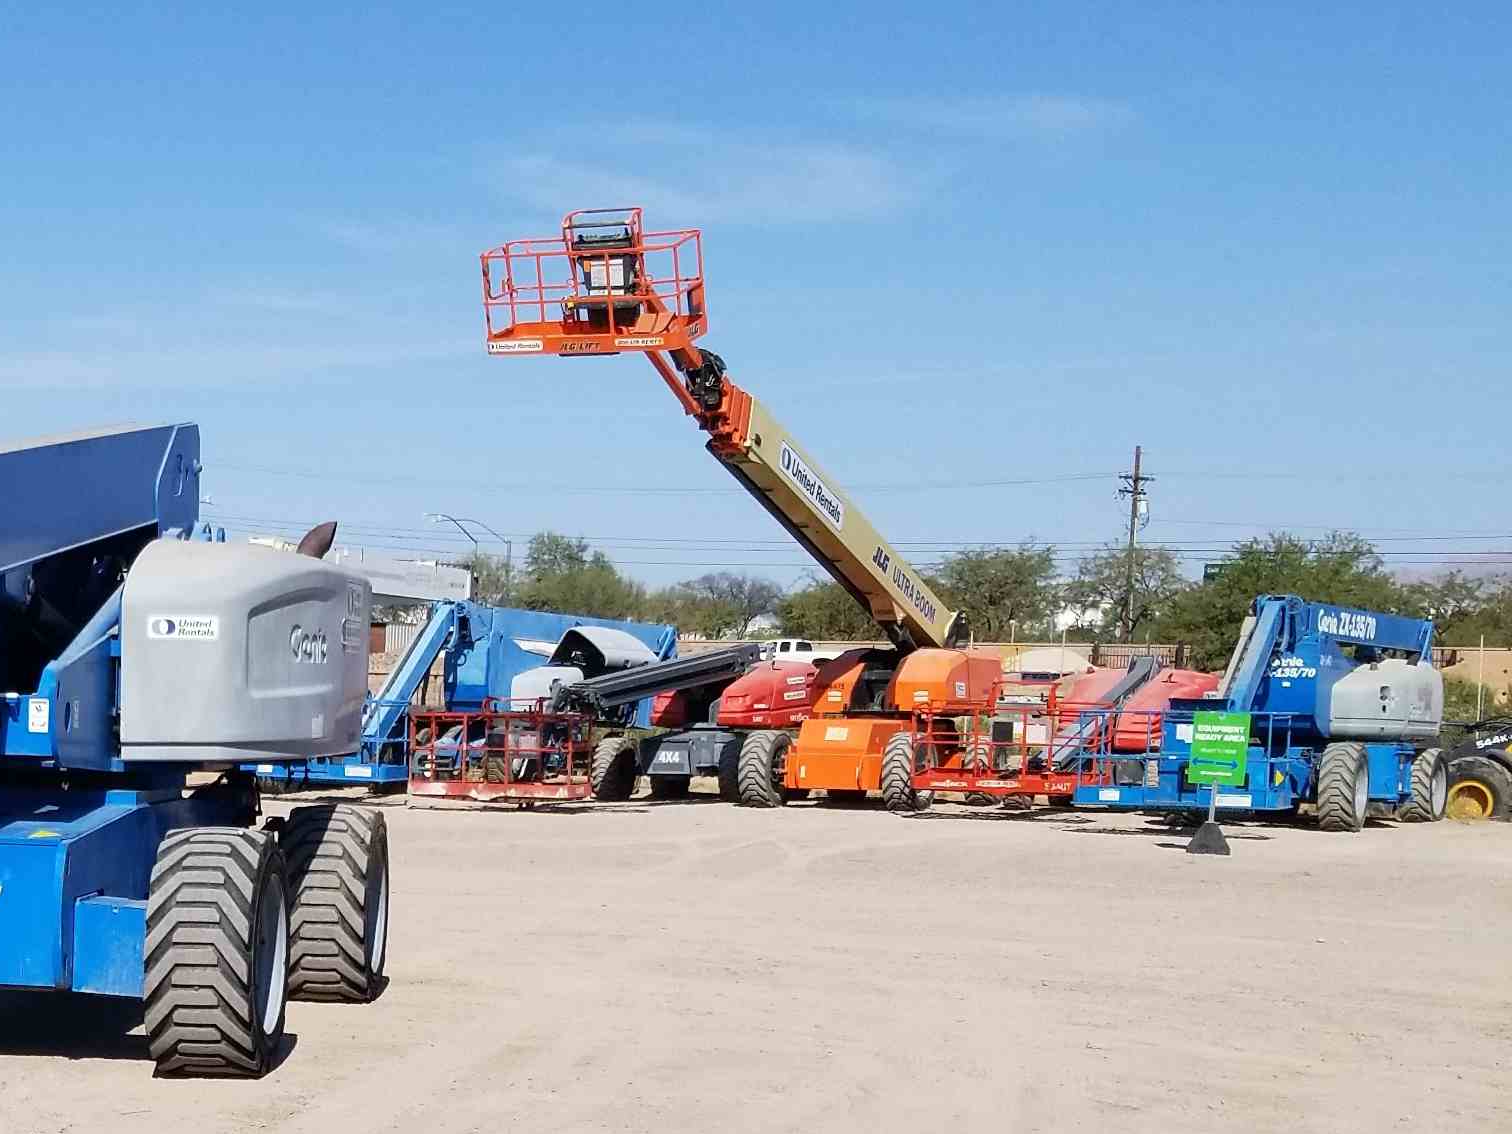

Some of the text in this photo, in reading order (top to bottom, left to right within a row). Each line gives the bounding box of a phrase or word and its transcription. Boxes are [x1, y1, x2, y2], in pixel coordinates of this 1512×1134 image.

[792, 459, 841, 524] United Rentals
[872, 546, 937, 625] JLG ULTRA BOOM
[178, 619, 212, 628] United
[178, 628, 215, 637] Rentals
[1318, 608, 1338, 635] Genie
[289, 623, 329, 664] Genie
